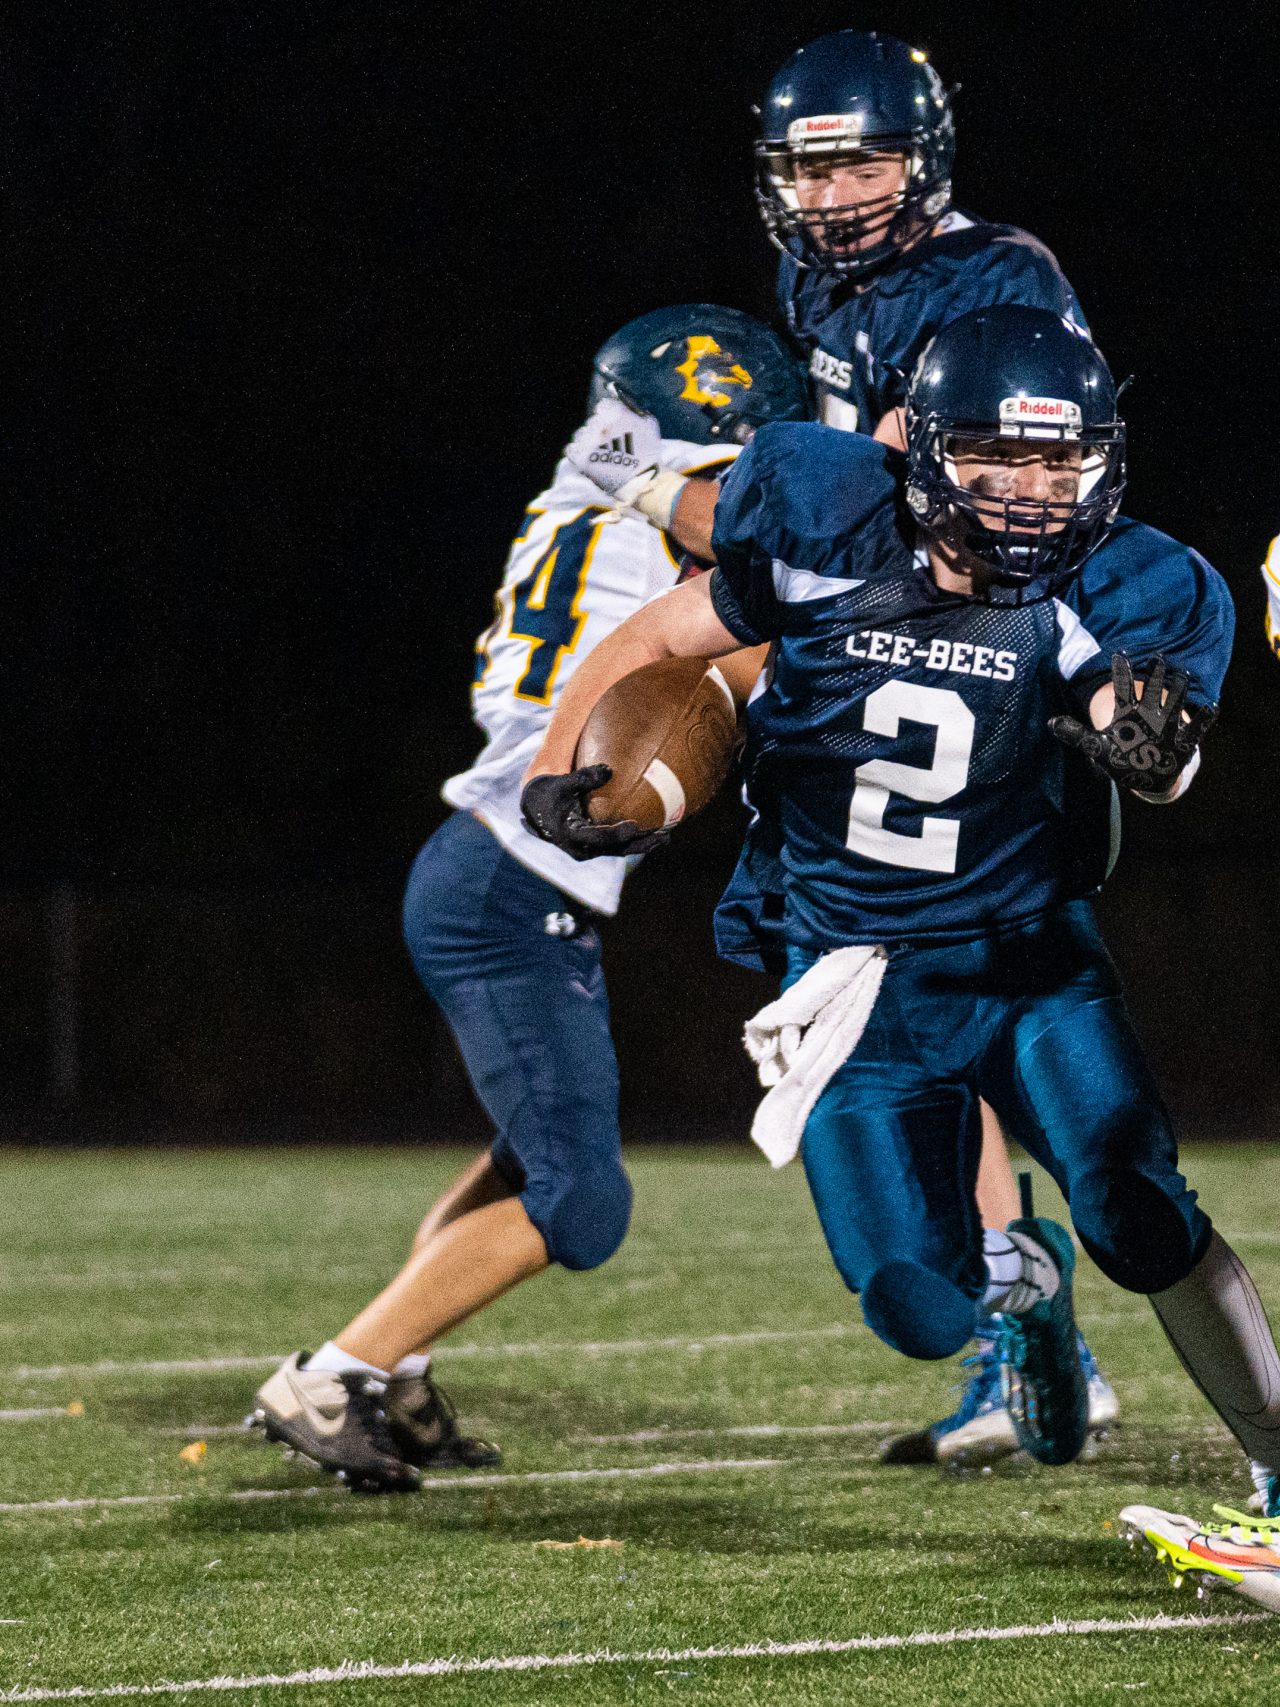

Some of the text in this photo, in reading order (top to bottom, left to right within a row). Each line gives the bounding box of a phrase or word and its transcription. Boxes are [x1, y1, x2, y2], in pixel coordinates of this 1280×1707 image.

[805, 118, 845, 132] Riddell
[1019, 401, 1063, 415] Riddell
[589, 449, 639, 469] adidas
[845, 630, 1018, 682] CEE-BEES
[845, 679, 976, 874] 2
